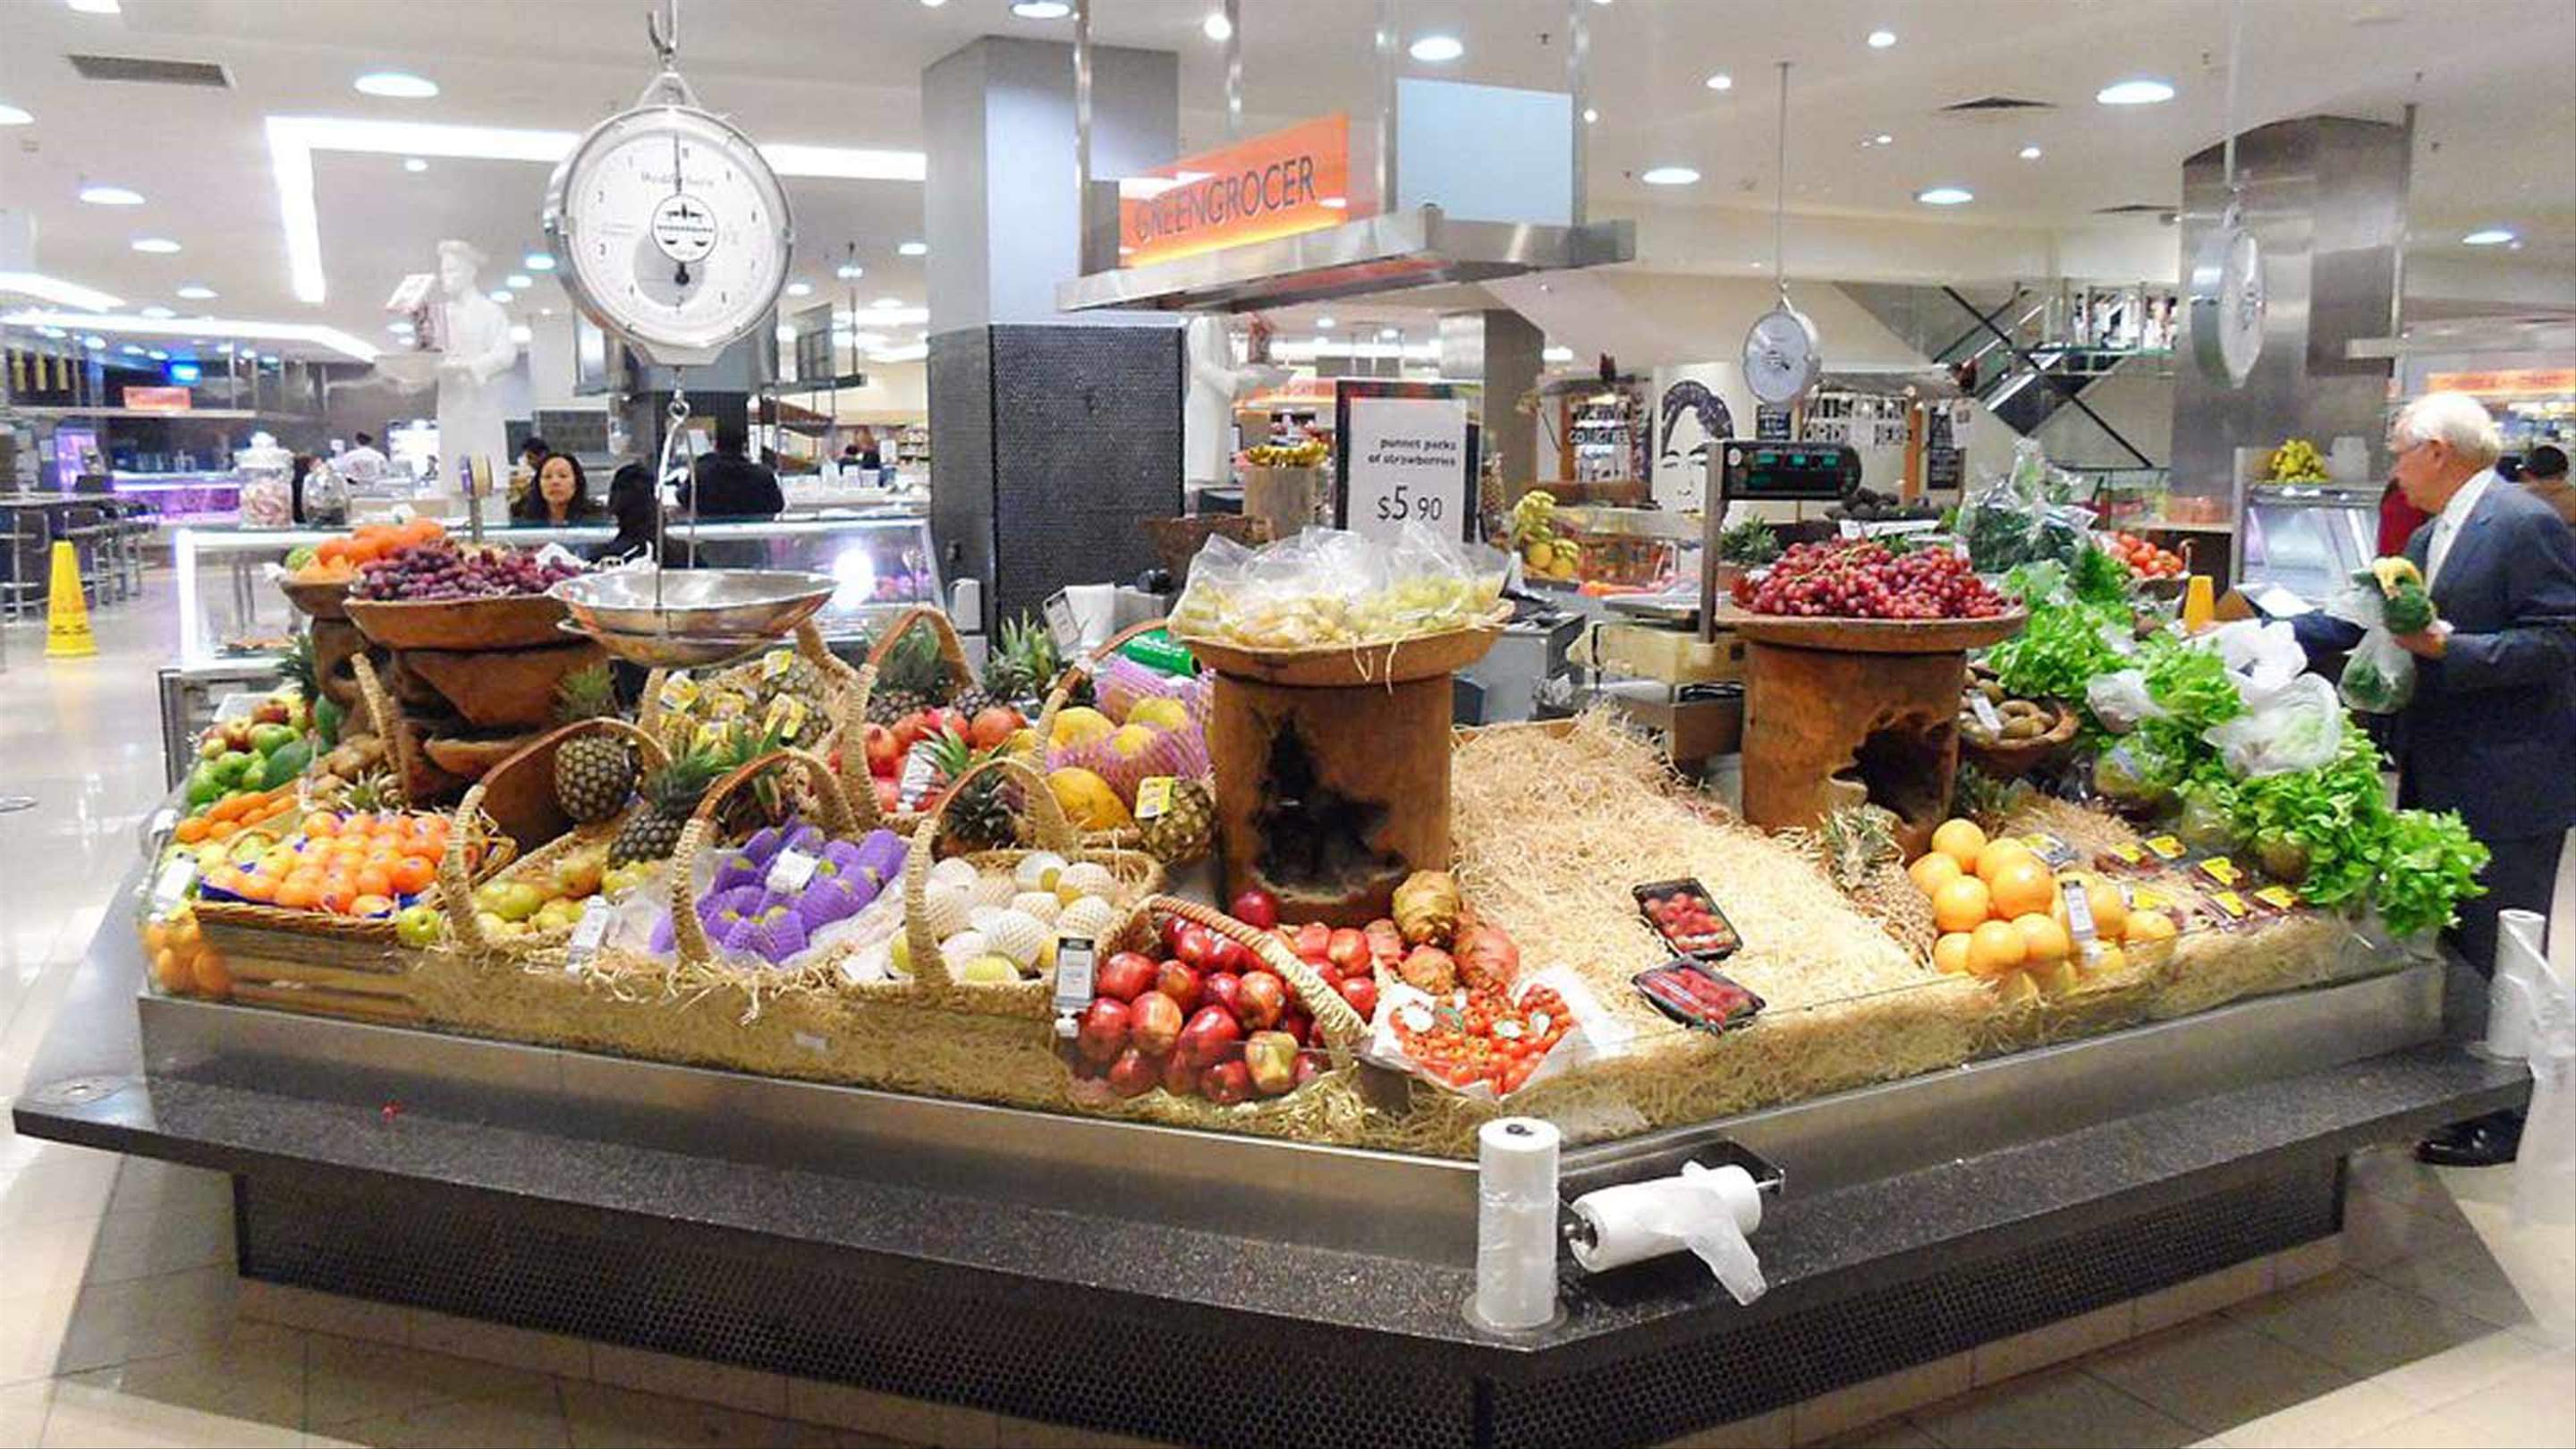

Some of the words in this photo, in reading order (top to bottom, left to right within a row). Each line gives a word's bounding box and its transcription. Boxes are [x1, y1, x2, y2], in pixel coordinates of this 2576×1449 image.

[1137, 156, 1315, 242] GREENGROCER
[1368, 453, 1380, 463] of
[1384, 454, 1454, 465] strawberries
[1377, 485, 1409, 521] $5
[1418, 496, 1442, 521] 90
